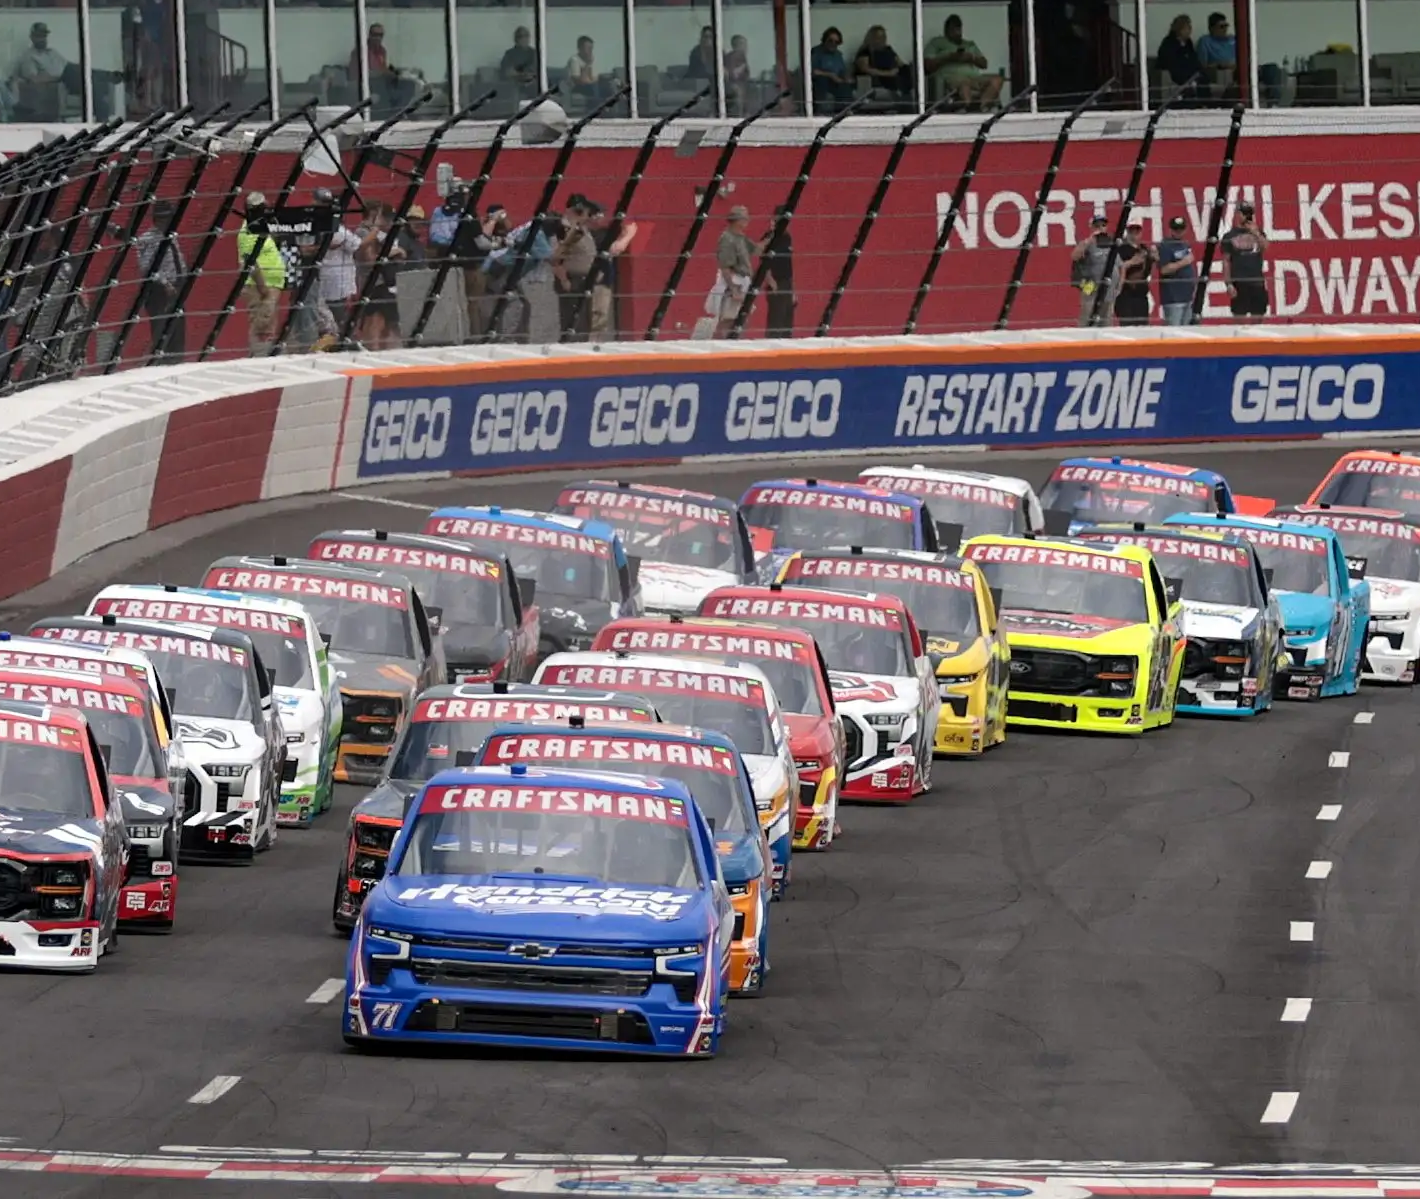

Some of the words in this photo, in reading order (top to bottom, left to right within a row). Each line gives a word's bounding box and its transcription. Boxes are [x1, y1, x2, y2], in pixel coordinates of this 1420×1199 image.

[935, 188, 1162, 250] NORTH
[724, 378, 843, 441] GEICO
[894, 371, 1056, 438] RESTART
[1054, 367, 1167, 432] ZONE
[1231, 363, 1386, 424] GEICO
[365, 397, 452, 463] GEICO
[470, 390, 568, 455] GEICO
[588, 383, 700, 448] GEICO
[865, 476, 1006, 507] CRAFTSMAN
[1060, 467, 1195, 494] CRAFTSMAN
[569, 490, 720, 522] CRAFTSMAN
[756, 488, 902, 519] CRAFTSMAN
[436, 519, 596, 553] CRAFTSMAN
[1089, 534, 1237, 563] RAFTSMAN
[1180, 525, 1315, 551] AFTSMAN
[321, 544, 486, 576] CRAFTSMAN
[801, 558, 962, 588] CRAFTSMAN
[971, 544, 1126, 574] CRAFTSMAN
[217, 570, 391, 605] CRAFTSMAN
[108, 600, 290, 634] CRAFTSMAN
[715, 598, 885, 627] CRAFTSMAN
[43, 628, 238, 664] CRAFTSMAN
[612, 631, 794, 660] CRAFTSMAN
[557, 667, 749, 699] CRAFTSMAN
[427, 701, 628, 722] CRAFTSMAN
[497, 736, 713, 770] CRAFTSMAN
[440, 787, 667, 821] CRAFTSMAN
[398, 883, 694, 904] Hendrick
[371, 1002, 403, 1030] 71
